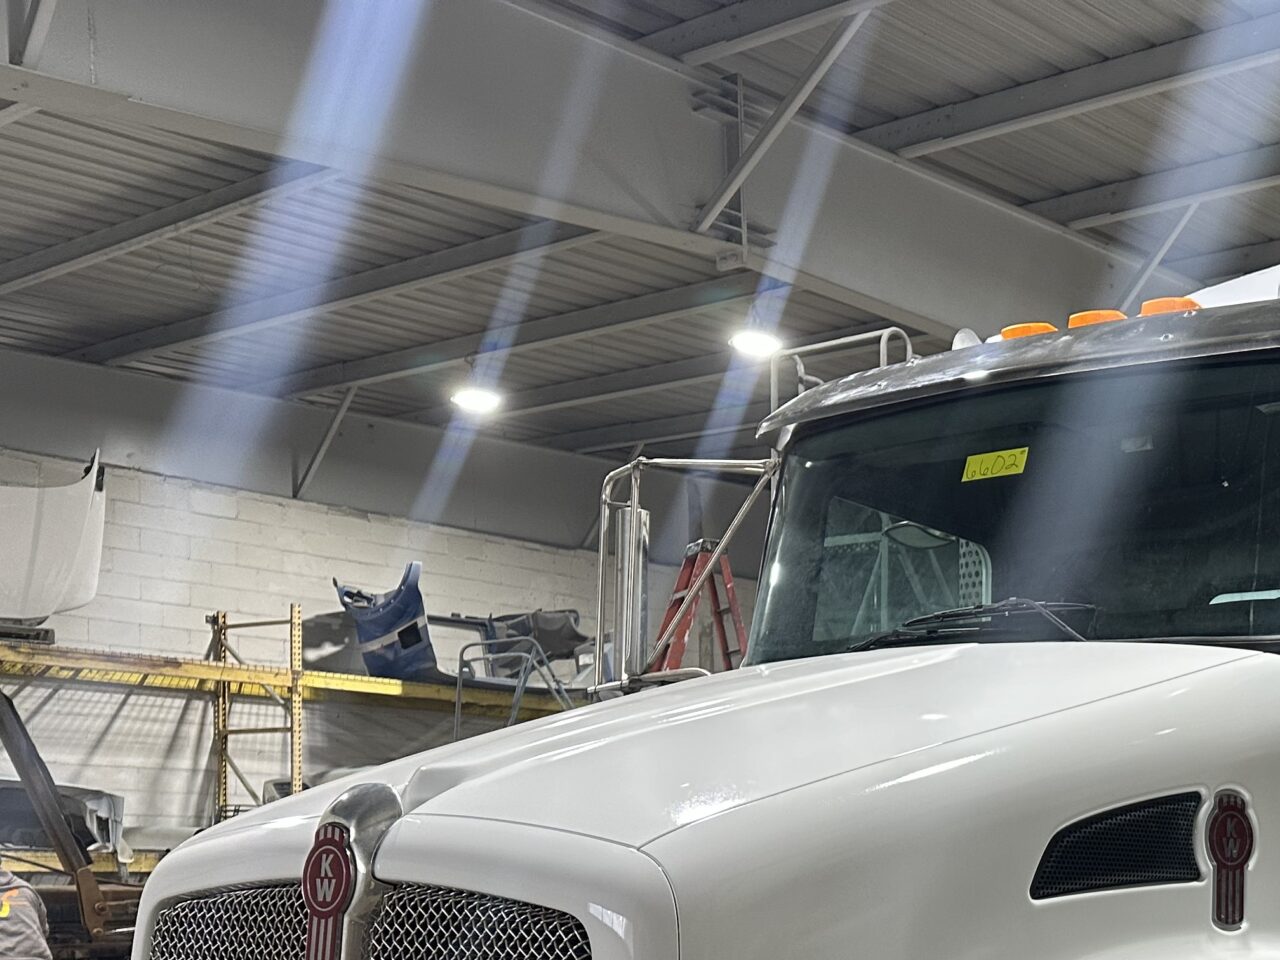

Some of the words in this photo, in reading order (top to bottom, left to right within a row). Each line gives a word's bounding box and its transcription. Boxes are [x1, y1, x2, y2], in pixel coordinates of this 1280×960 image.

[965, 453, 1019, 480] 6602
[1226, 817, 1238, 837] K
[1222, 837, 1241, 858] W
[320, 853, 335, 878] K
[315, 878, 337, 902] W
